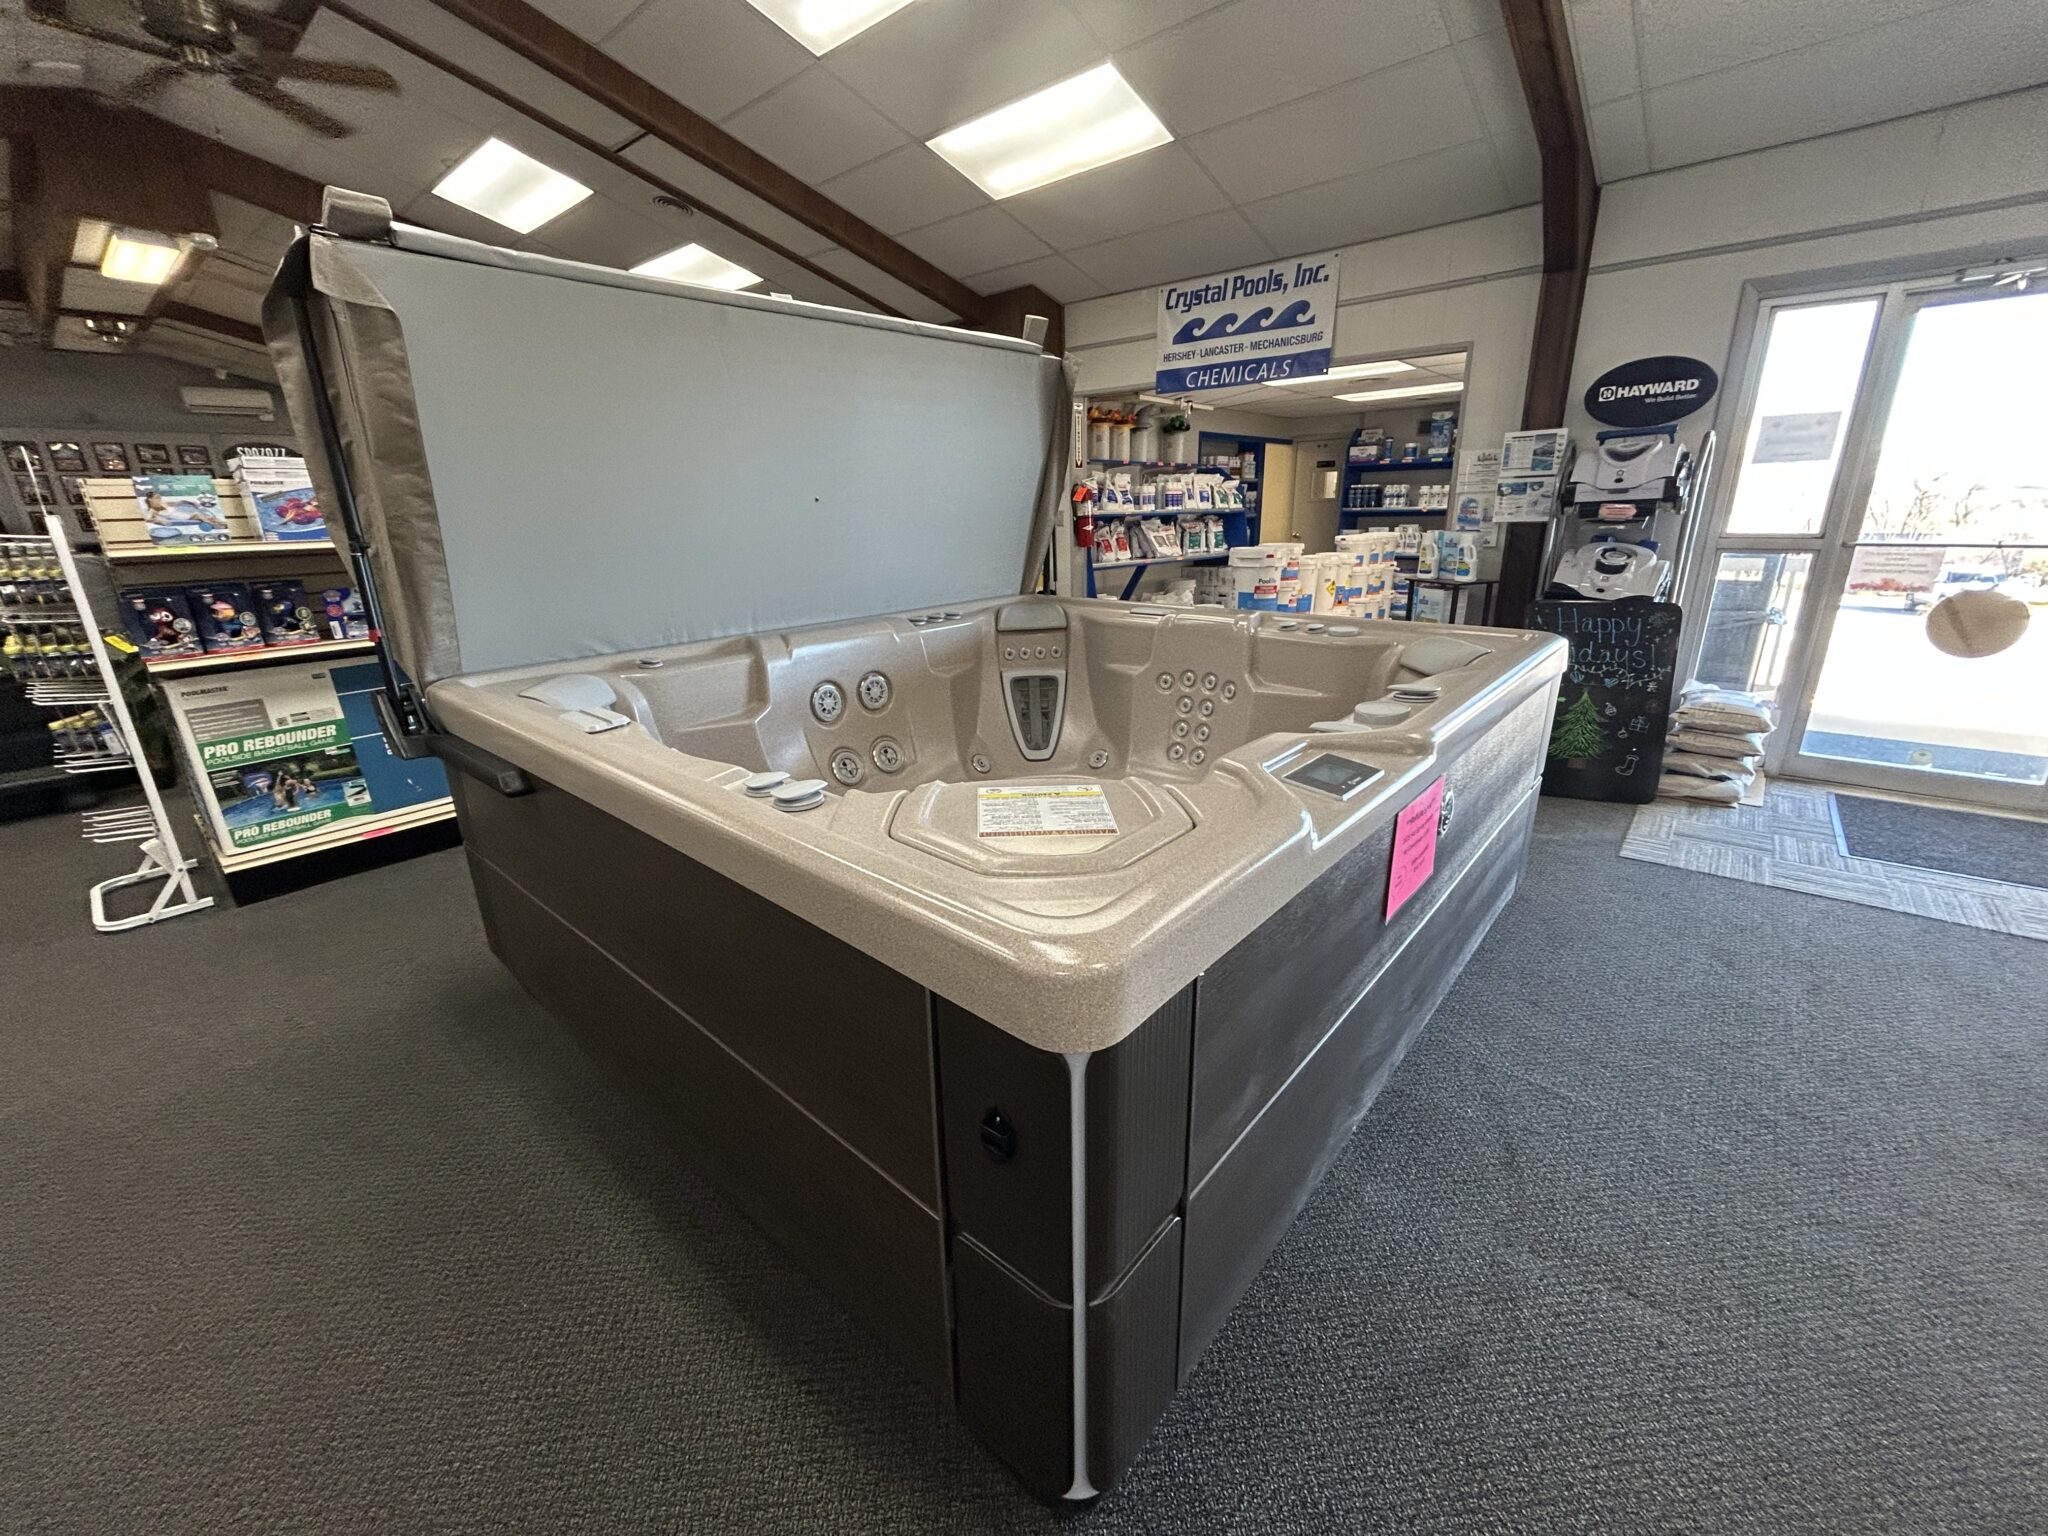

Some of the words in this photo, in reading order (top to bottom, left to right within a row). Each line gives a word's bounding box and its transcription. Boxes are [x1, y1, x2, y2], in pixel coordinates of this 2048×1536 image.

[1165, 278, 1228, 314] Crystal
[1231, 269, 1288, 299] Pools,
[1293, 263, 1330, 288] Inc.
[1163, 349, 1197, 363] HERSHEY
[1200, 342, 1244, 358] LANCASTER
[1250, 331, 1324, 351] MECHANICSBURG
[1186, 359, 1292, 388] CHEMICALS
[1616, 378, 1700, 399] HAYWARD
[1558, 607, 1642, 647] Happy
[1569, 641, 1655, 676] idays!
[180, 686, 229, 698] POOLMASTER
[203, 742, 239, 759] PRO
[243, 724, 337, 752] REBOUNDER
[206, 752, 252, 766] POOLSIDE
[253, 741, 309, 756] BASKETBALL
[309, 736, 336, 746] GAME
[233, 826, 260, 840] PRO
[262, 809, 332, 833] REBOUNDER
